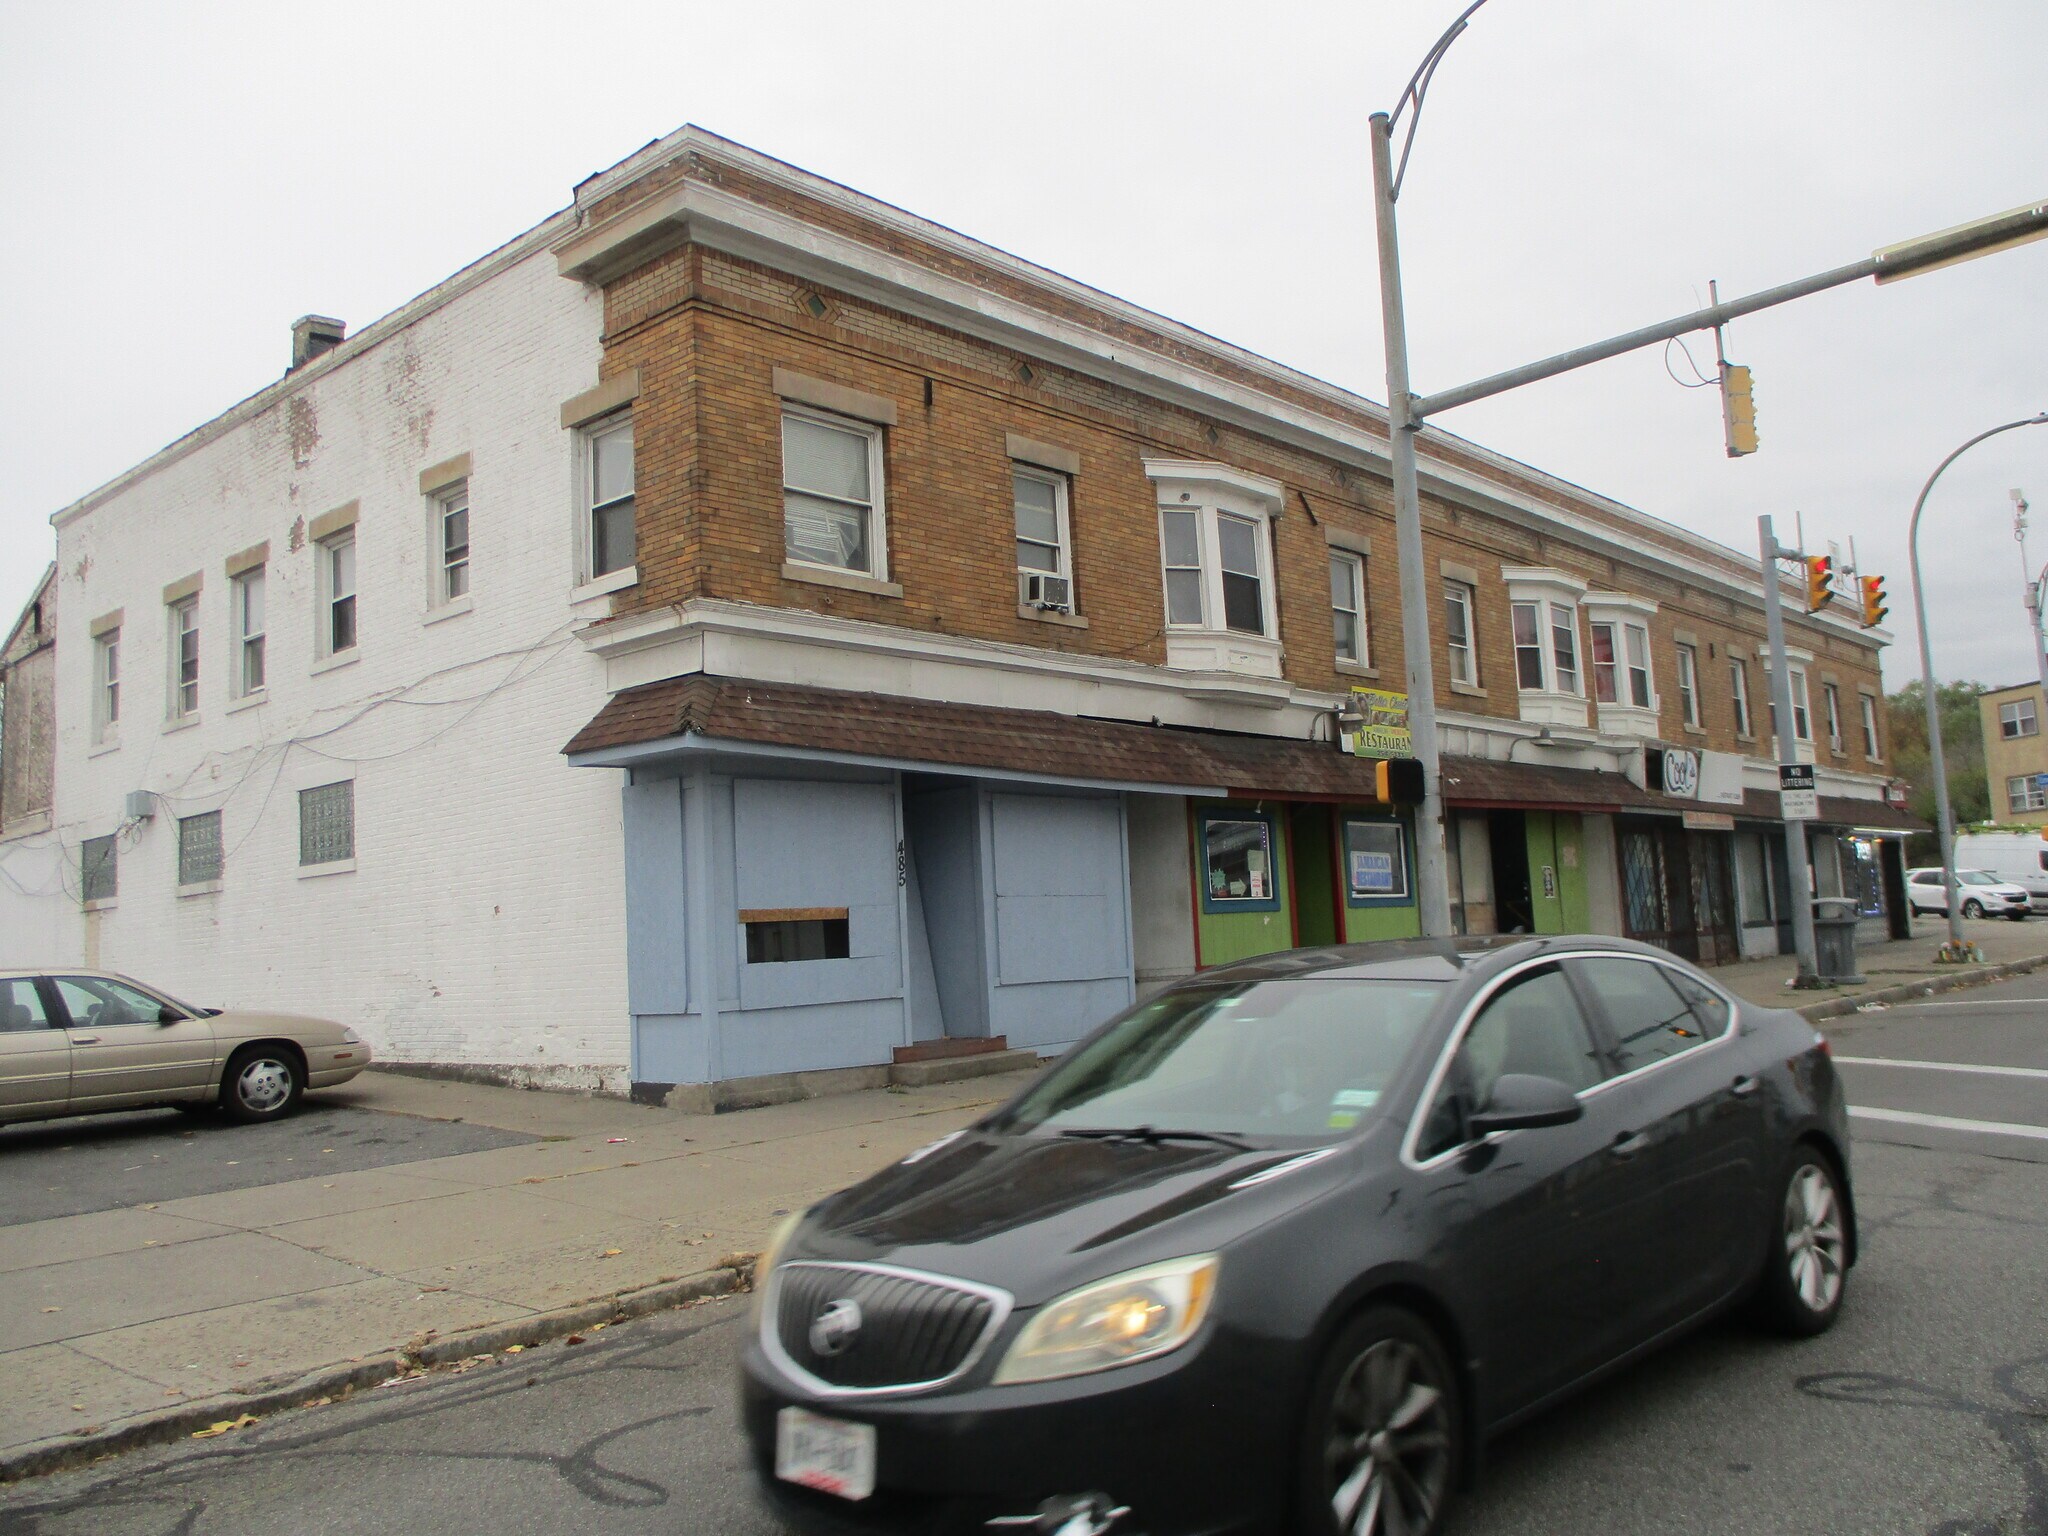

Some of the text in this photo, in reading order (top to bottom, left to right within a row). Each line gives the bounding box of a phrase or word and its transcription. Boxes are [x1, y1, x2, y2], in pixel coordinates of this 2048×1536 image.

[1360, 730, 1411, 751] RESTAURAN
[1790, 767, 1801, 776] NO
[1782, 778, 1812, 787] LITTERING
